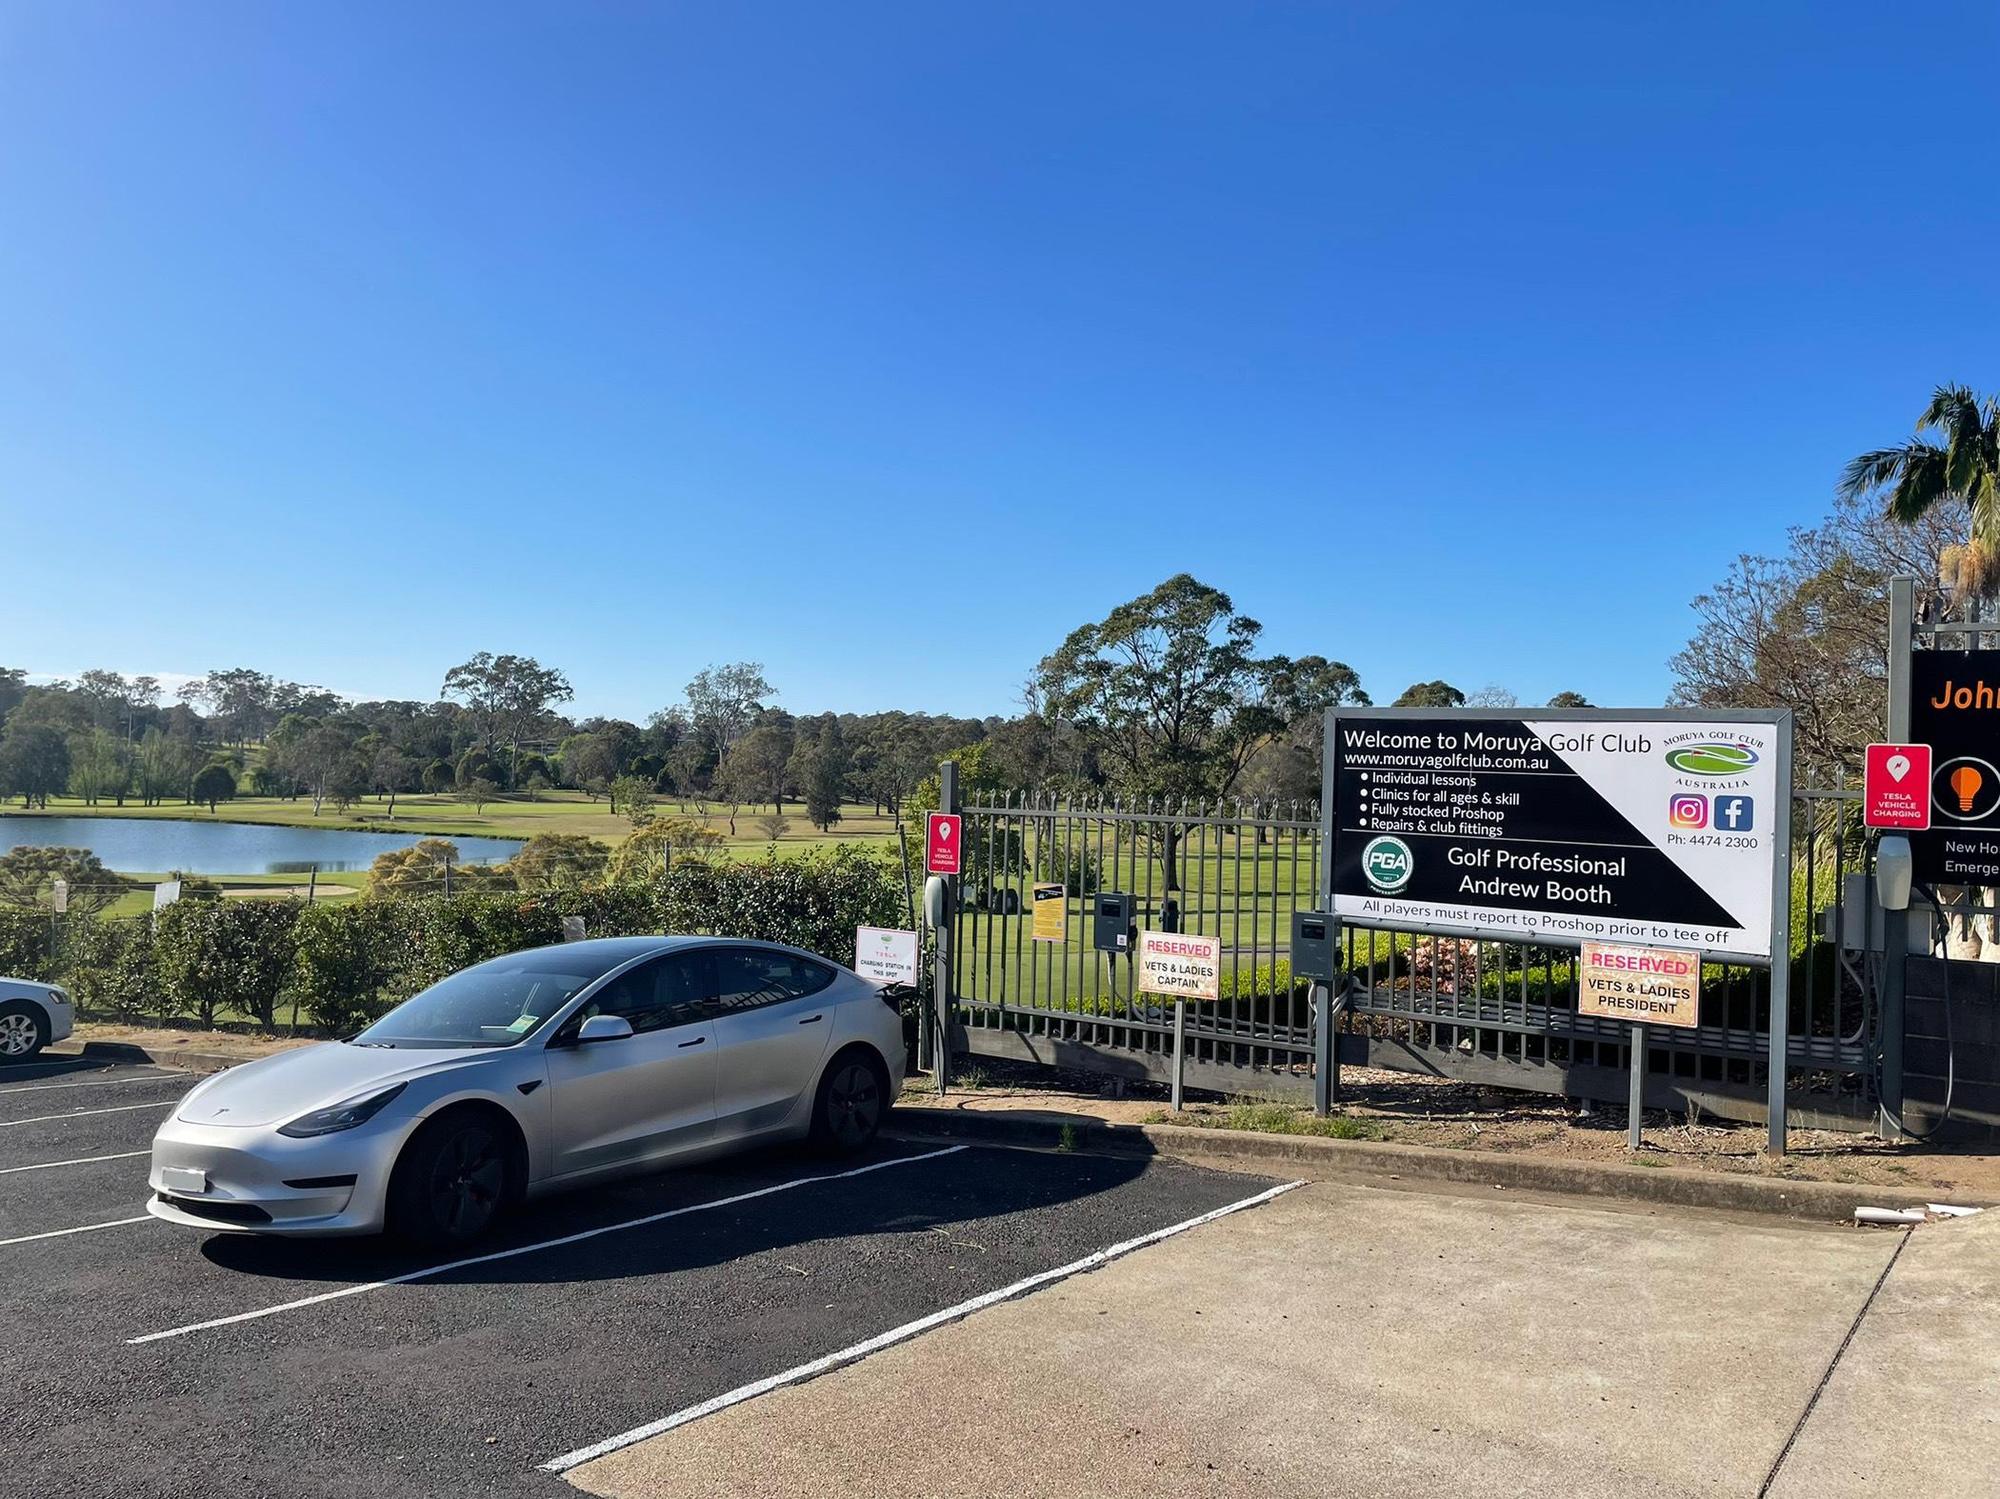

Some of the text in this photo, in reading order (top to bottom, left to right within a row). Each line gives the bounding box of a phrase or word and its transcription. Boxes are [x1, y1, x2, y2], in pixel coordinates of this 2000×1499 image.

[1931, 680, 2000, 709] Joh
[1344, 730, 1651, 755] Welcome to Moruya Golf Club
[1663, 731, 1764, 749] MORUYA GOLF CLUB
[1344, 753, 1549, 770] www.moruyagolfclub.com.au
[1372, 772, 1477, 787] Individual lessons
[1676, 778, 1750, 790] AUSTRALIA
[1371, 788, 1520, 806] Clinics for all ages & skill
[1878, 801, 1917, 810] VEHICLE
[1371, 803, 1505, 822] Fully stocked Proshop
[1873, 809, 1921, 818] CHARGING
[1371, 818, 1503, 838] Repairs & club fittings
[1667, 833, 1758, 849] Ph: 4474 2300
[1945, 840, 2000, 855] New Ho
[1369, 851, 1406, 870] PGA
[1447, 847, 1625, 877] Golf Professional
[1459, 875, 1611, 904] Andrew Booth
[1363, 899, 1729, 944] All players must report to Proshop prior to tee off
[1147, 940, 1211, 957] RESERVED
[1145, 961, 1213, 977] VETS & LADIES
[1591, 953, 1688, 975] RESERVED
[1157, 975, 1199, 989] CAPTAIN
[1588, 978, 1690, 1000] VETS & LADIES
[1598, 995, 1677, 1014] PRESIDENT
